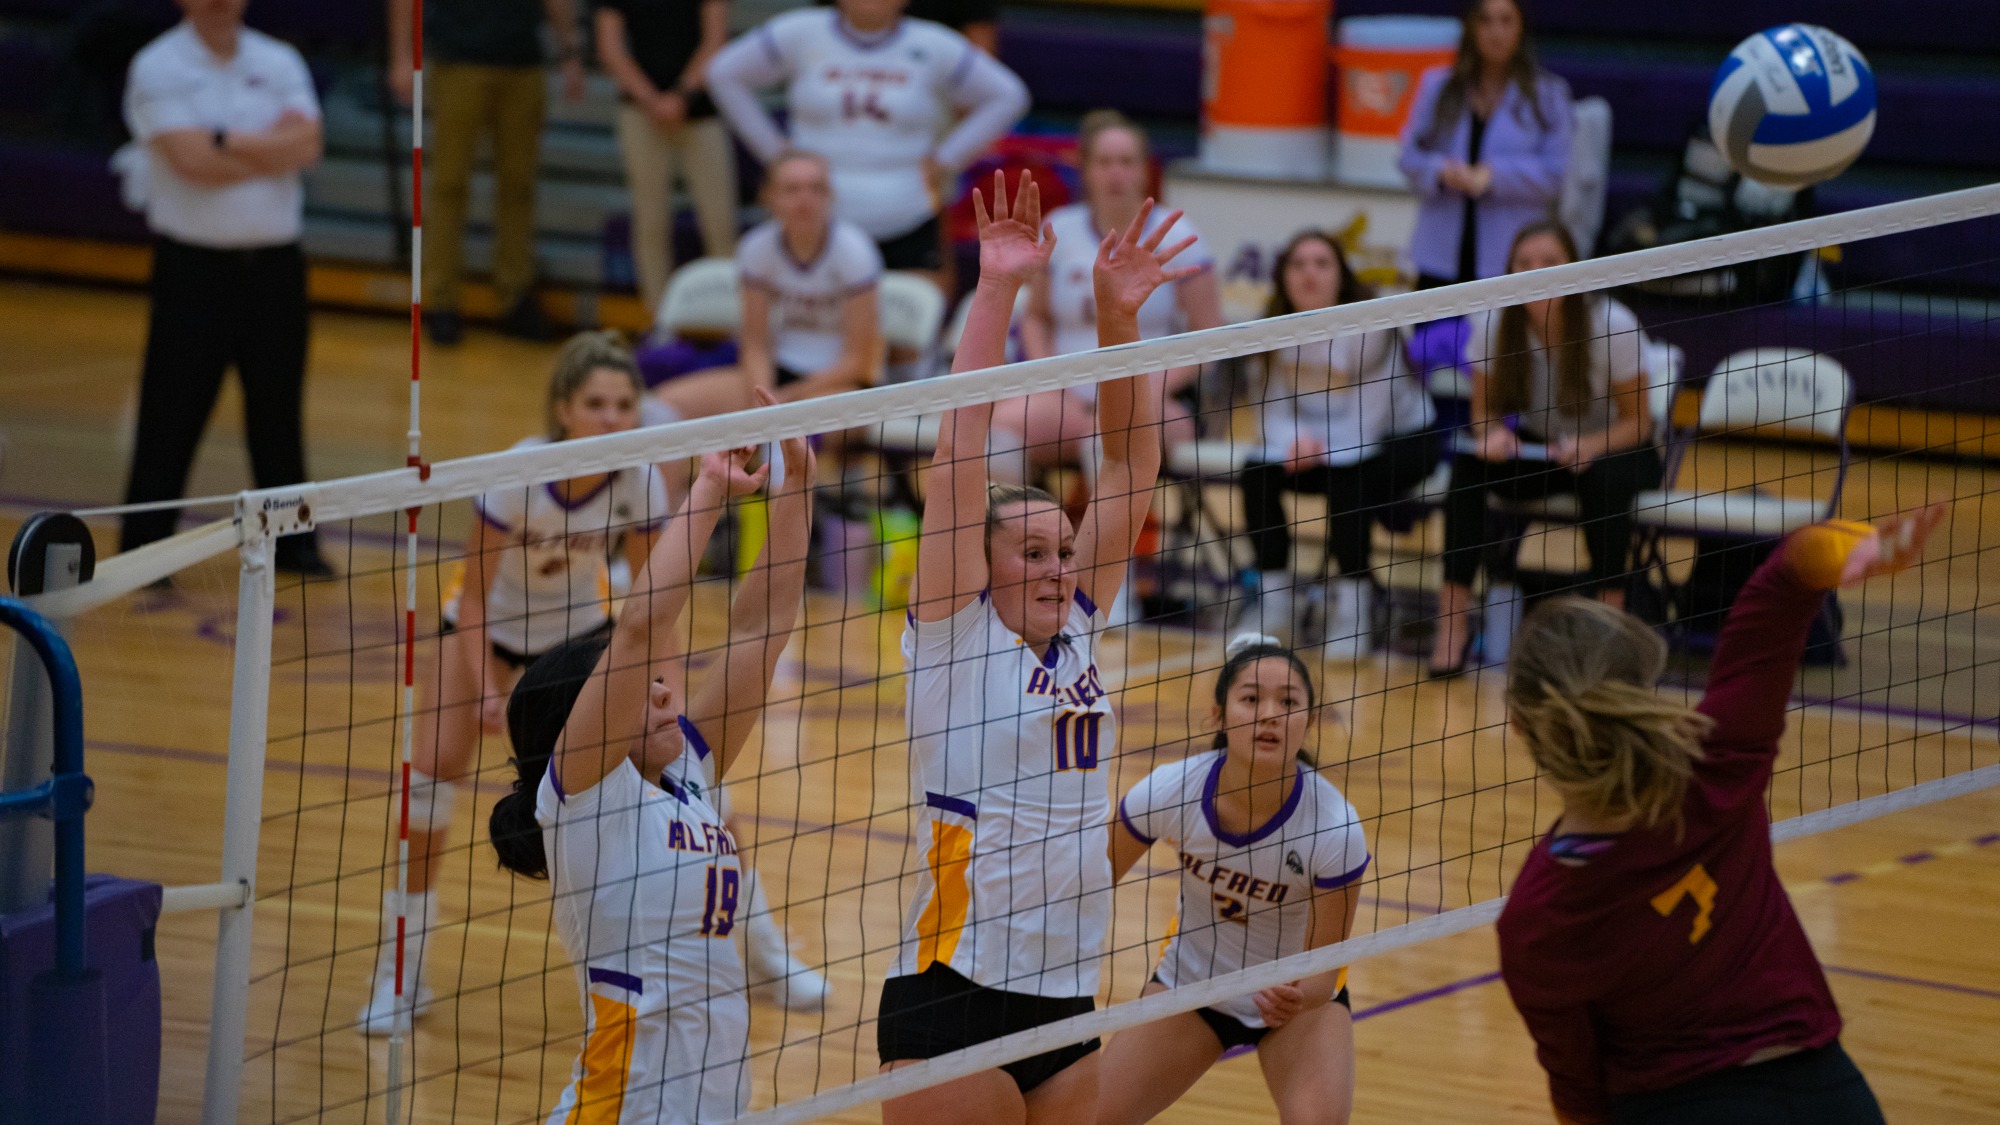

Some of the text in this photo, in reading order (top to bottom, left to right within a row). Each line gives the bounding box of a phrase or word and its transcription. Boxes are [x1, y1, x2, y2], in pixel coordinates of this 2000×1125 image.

[1054, 711, 1105, 773] 10
[699, 864, 739, 938] 19
[1650, 863, 1718, 945] 7
